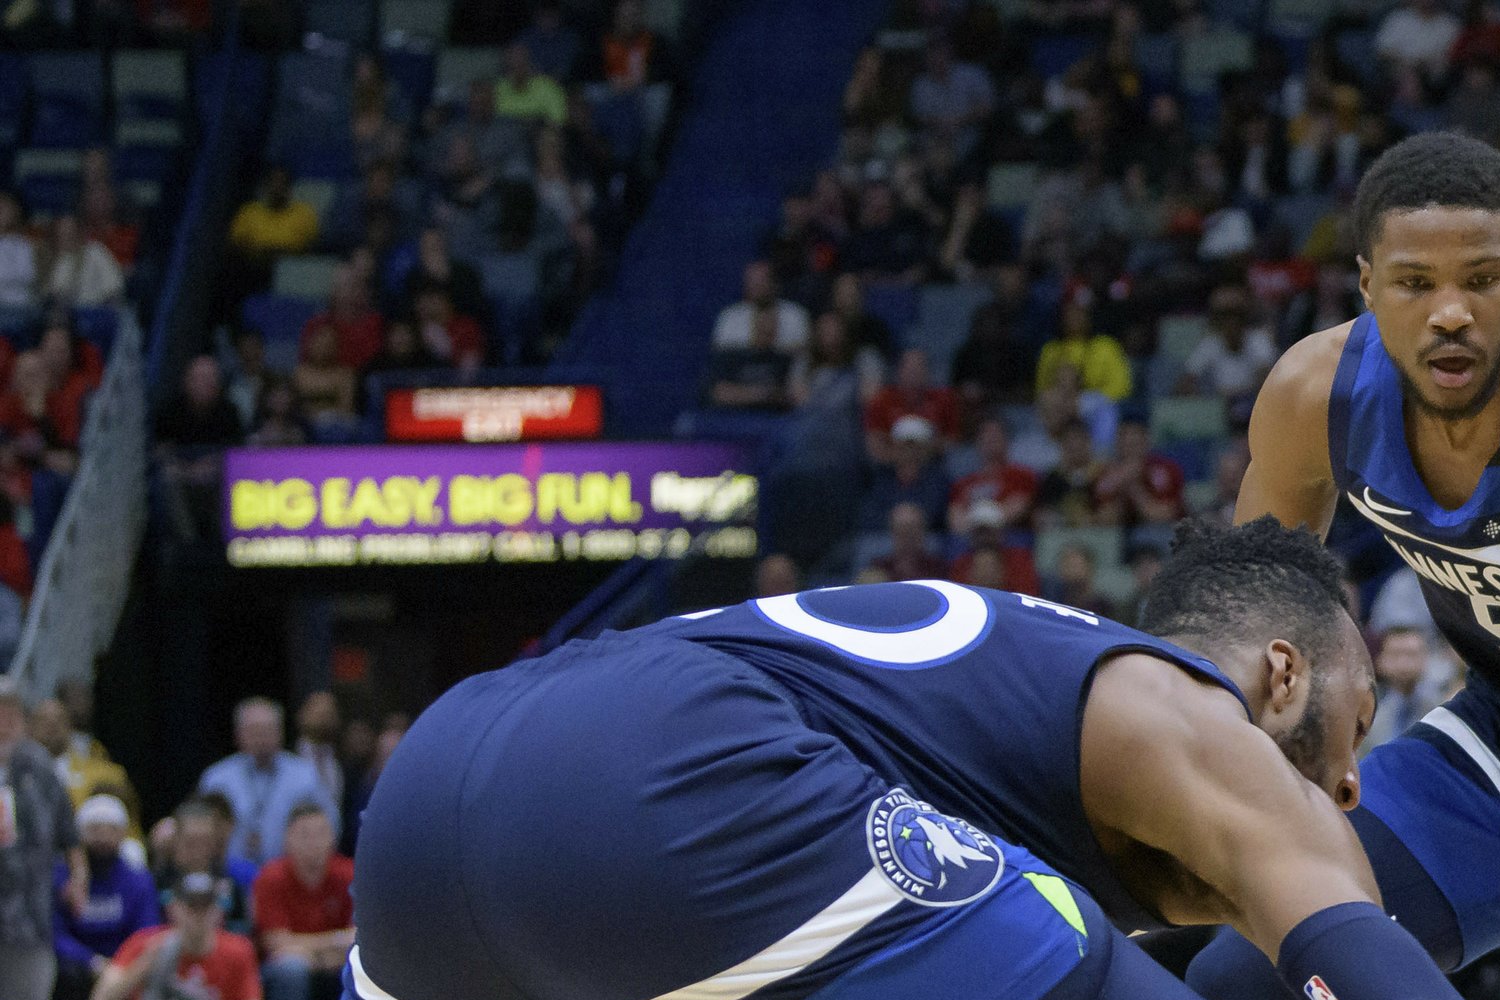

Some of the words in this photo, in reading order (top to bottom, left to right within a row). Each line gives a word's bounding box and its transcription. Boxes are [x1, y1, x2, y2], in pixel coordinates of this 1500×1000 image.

[231, 479, 316, 529] BIG
[449, 474, 533, 526] BIG
[873, 809, 925, 896] MINNESOTA
